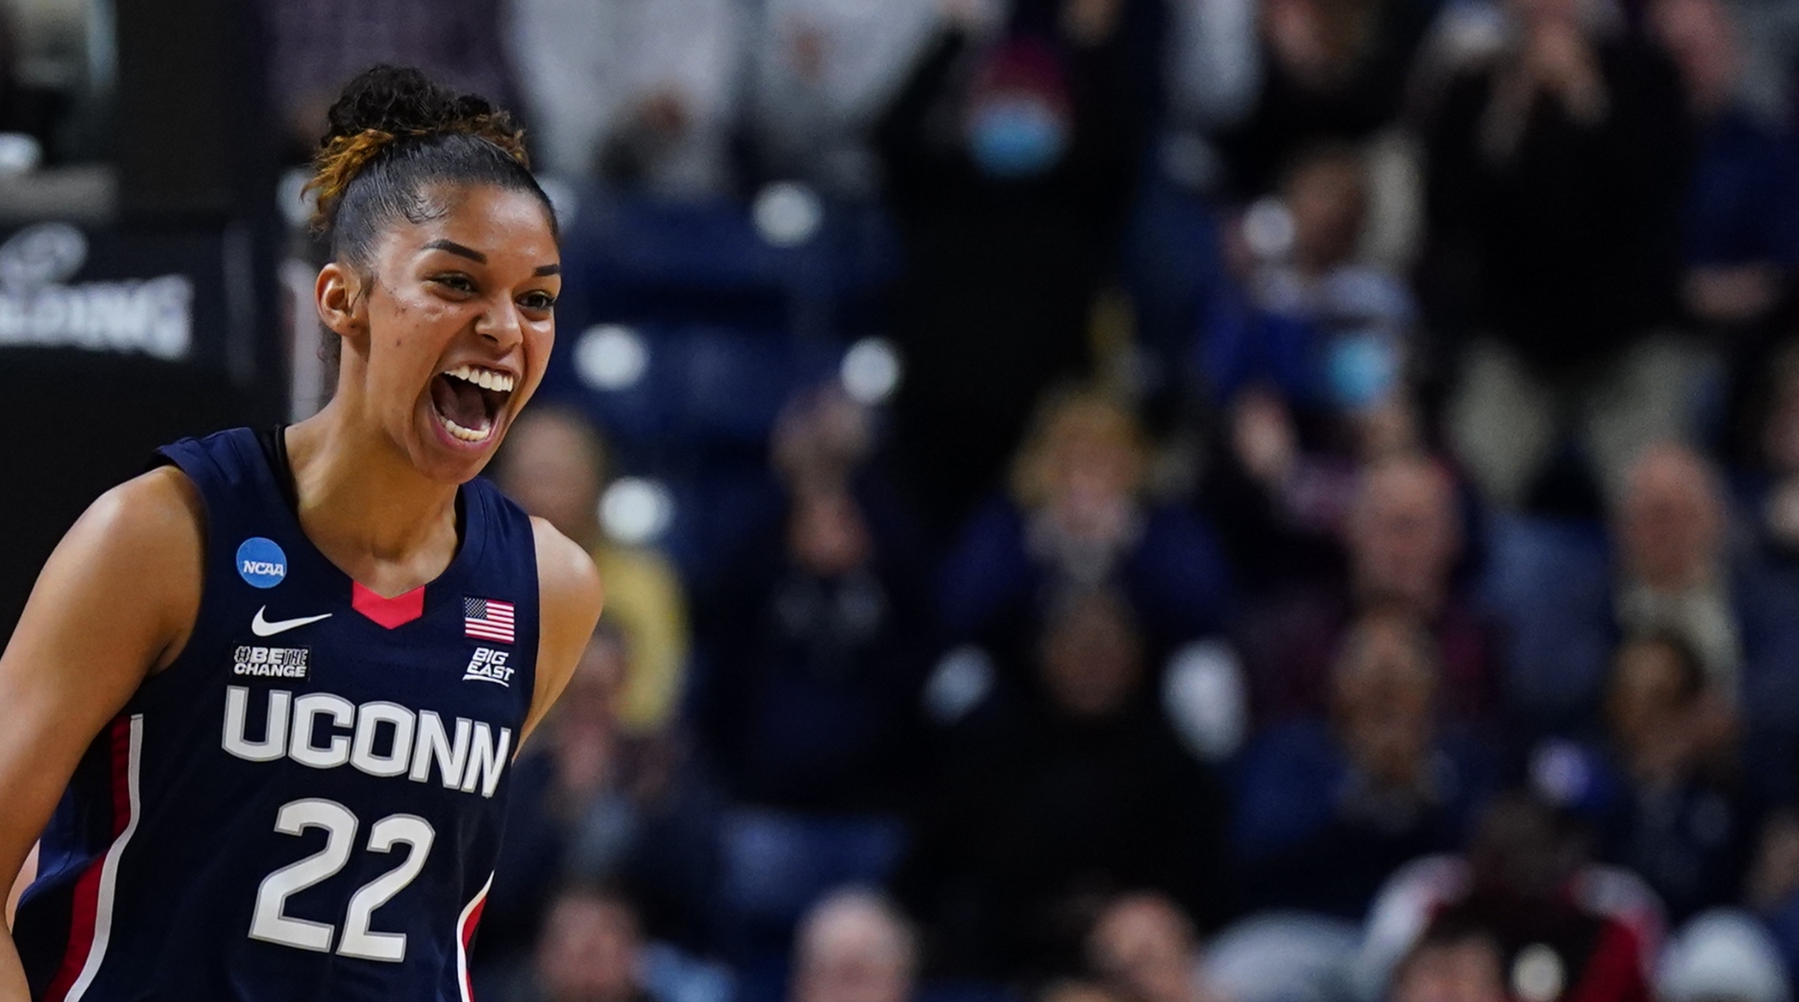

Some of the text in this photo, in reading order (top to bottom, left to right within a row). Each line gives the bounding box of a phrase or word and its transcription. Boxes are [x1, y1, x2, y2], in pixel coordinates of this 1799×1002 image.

[243, 560, 284, 576] NCAA
[472, 647, 509, 665] BIG
[234, 664, 306, 677] CHANGE
[466, 660, 515, 681] EAST
[221, 685, 511, 798] UCONN
[248, 797, 436, 963] 22
